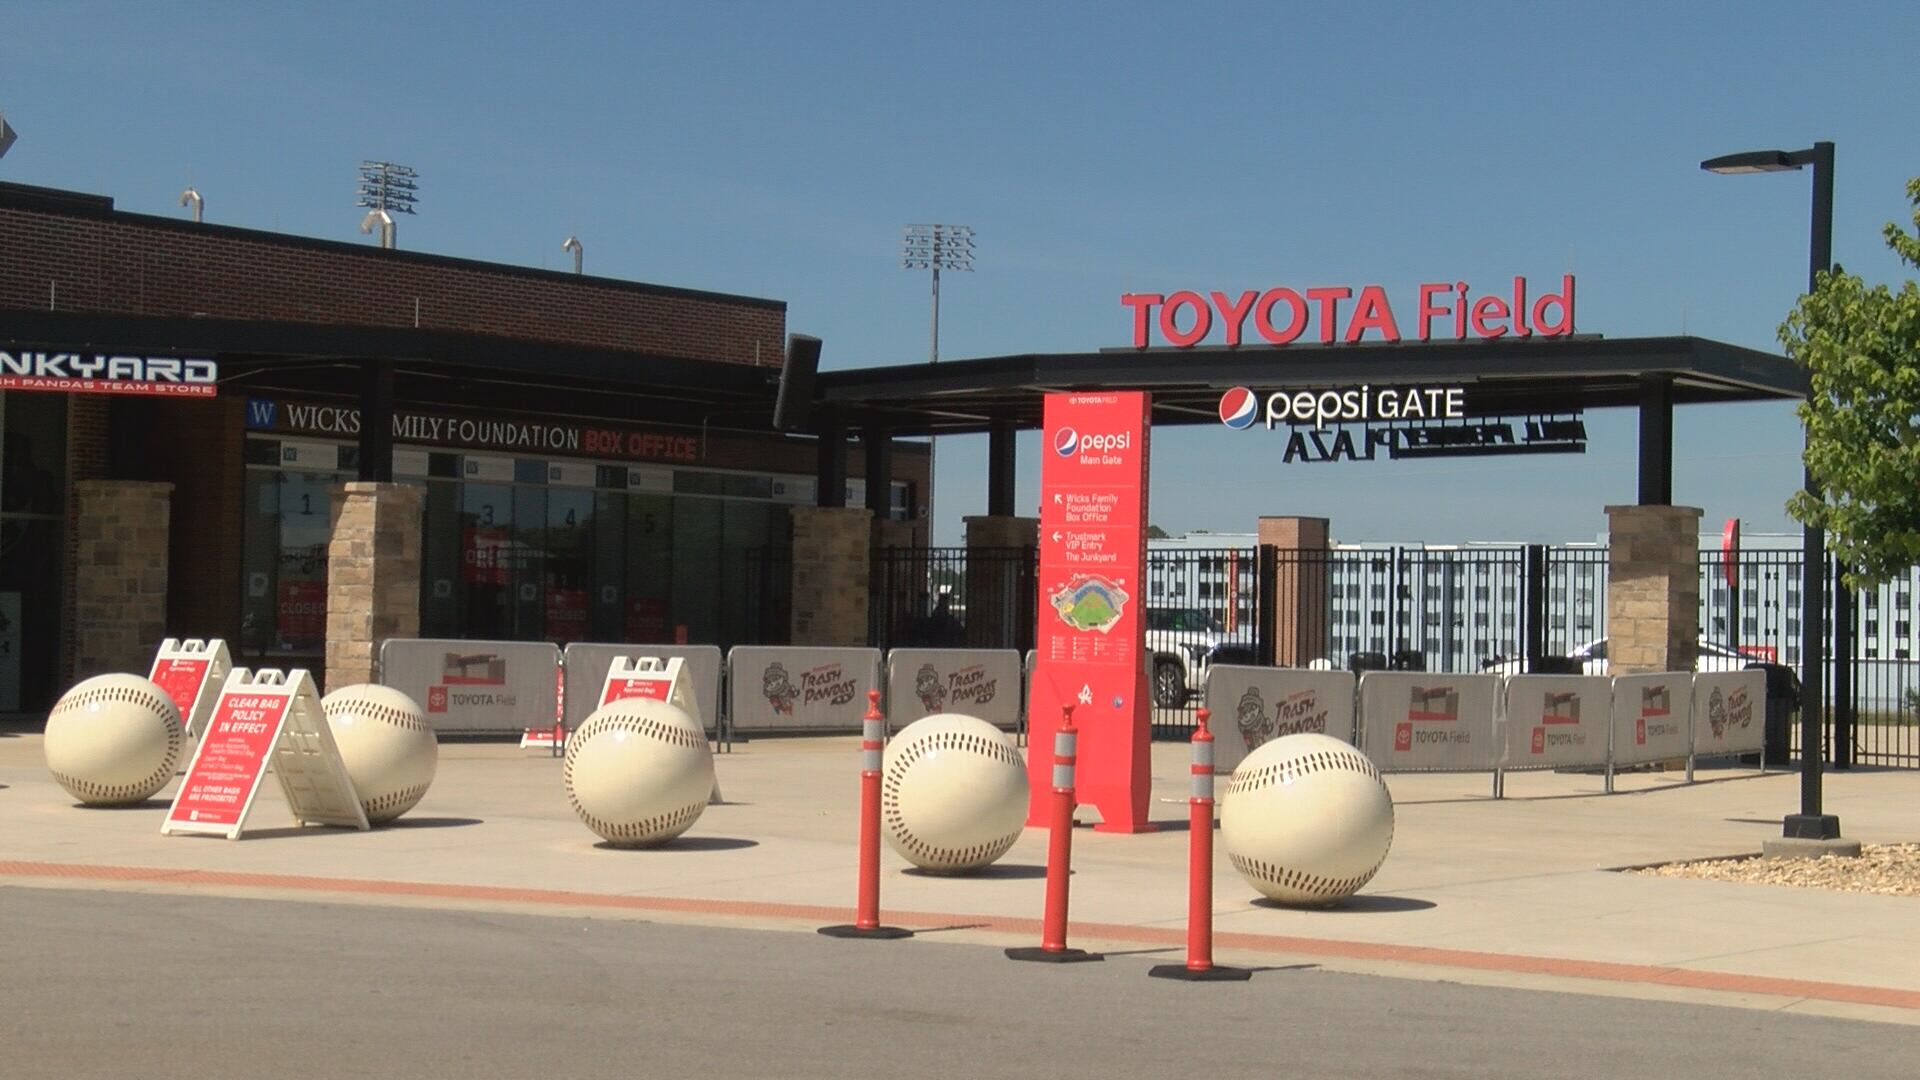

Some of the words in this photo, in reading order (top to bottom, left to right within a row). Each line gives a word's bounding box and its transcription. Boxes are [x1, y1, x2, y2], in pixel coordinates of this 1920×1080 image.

[1121, 286, 1401, 349] TOYOTA
[1419, 274, 1575, 343] Field
[23, 379, 94, 389] PANDAS
[101, 382, 149, 391] TEAM
[155, 384, 213, 394] STORE
[252, 402, 274, 425] W
[286, 404, 360, 433] WICKS
[1266, 385, 1368, 430] pepsi
[1377, 388, 1464, 418] GATE
[448, 419, 579, 449] FOUNDATION
[584, 429, 623, 454] BOX
[629, 433, 696, 459] OFFICE
[1080, 431, 1130, 453] pepsi
[1080, 455, 1100, 465] Main
[1102, 455, 1122, 465] Gate
[302, 493, 312, 514] 1
[1066, 503, 1111, 512] Foundation
[1092, 494, 1118, 504] Family
[482, 504, 494, 525] 3
[565, 508, 576, 528] 4
[1066, 512, 1080, 521] Box
[1082, 512, 1108, 521] Office
[1065, 541, 1080, 549] VIP
[1081, 541, 1102, 551] Entry
[1065, 552, 1080, 561] The
[1081, 552, 1117, 563] Junkyard
[800, 669, 841, 690] TRASH
[948, 670, 984, 691] TRASH
[451, 694, 494, 706] TOYOTA
[804, 679, 857, 707] PANDAS
[952, 679, 997, 706] PANDAS
[228, 697, 259, 708] CLEAR
[259, 698, 280, 709] BAG
[1275, 696, 1315, 725] TRASH
[230, 709, 266, 721] POLICY
[219, 721, 231, 733] IN
[231, 722, 267, 734] EFFECT
[1415, 730, 1448, 743] TOYOTA
[1449, 730, 1471, 744] Field
